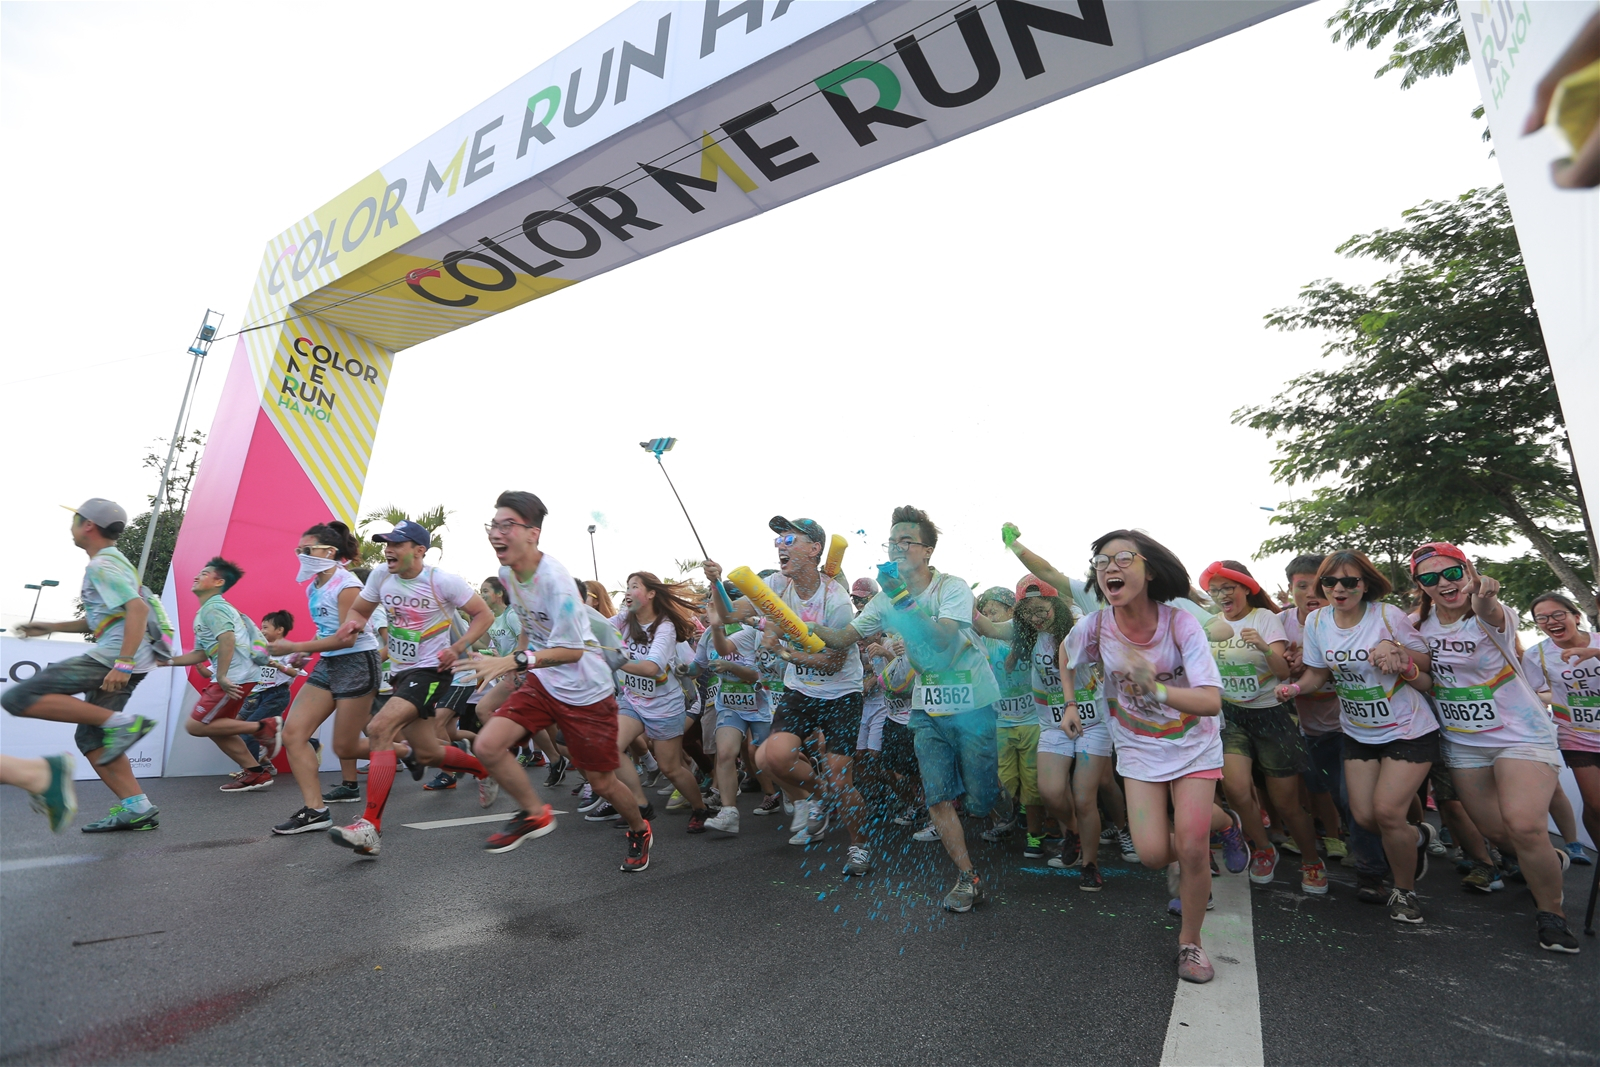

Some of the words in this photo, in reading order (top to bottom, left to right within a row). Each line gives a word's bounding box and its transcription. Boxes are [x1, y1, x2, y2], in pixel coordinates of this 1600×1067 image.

[268, 178, 408, 296] COLOR
[416, 115, 504, 215] ME
[516, 12, 672, 160] RUN
[406, 185, 664, 308] COLOR
[636, 101, 820, 214] ME
[813, 0, 1114, 147] RUN
[293, 337, 379, 385] COLOR
[281, 375, 336, 411] RUN
[384, 594, 430, 609] COLOR
[1428, 638, 1476, 654] OLOR
[1325, 649, 1369, 662] COLO
[260, 667, 275, 679] 352
[625, 675, 654, 692] A3193
[1221, 677, 1257, 693] 2948
[723, 694, 754, 705] A3343
[925, 686, 971, 705] A3562
[1000, 694, 1034, 711] B7732
[1052, 703, 1096, 722] B39
[1341, 699, 1389, 717] B5570
[1440, 702, 1495, 721] B6623
